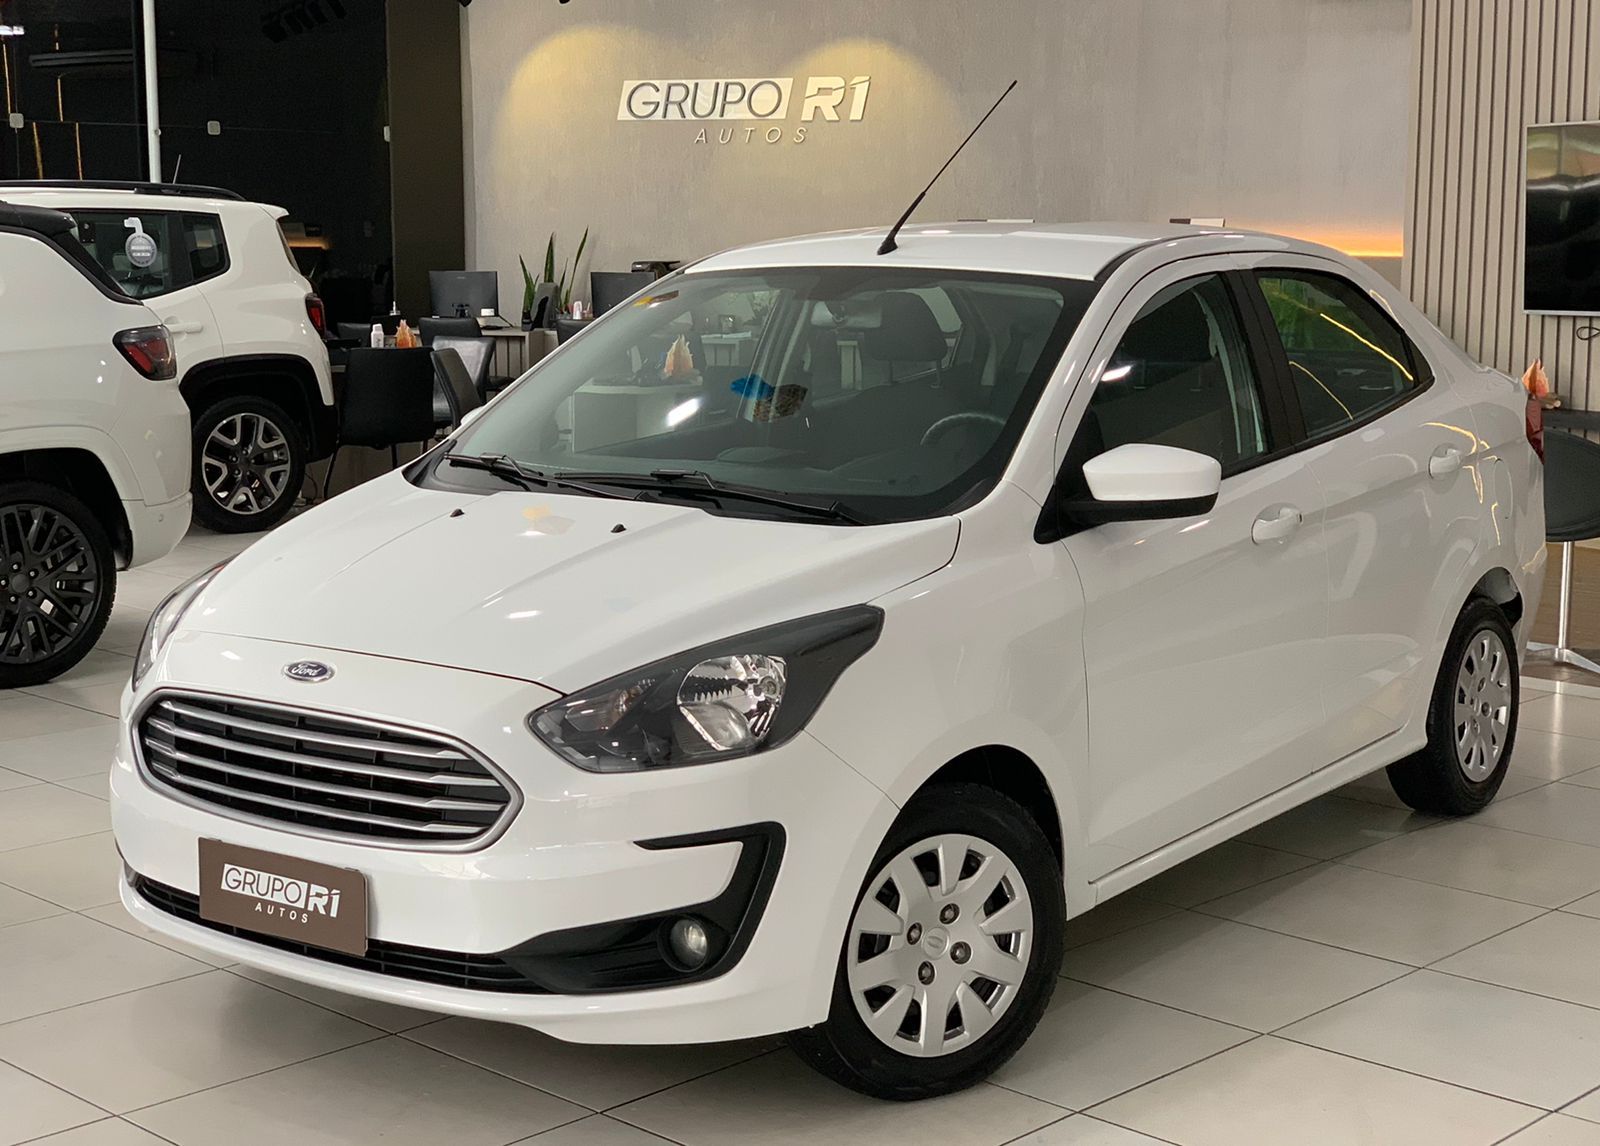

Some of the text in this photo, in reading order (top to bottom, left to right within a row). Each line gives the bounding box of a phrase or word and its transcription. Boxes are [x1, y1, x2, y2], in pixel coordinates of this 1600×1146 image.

[626, 76, 871, 121] GRUPO R1
[694, 127, 808, 144] AUTOS
[291, 663, 322, 676] Ford
[225, 867, 341, 918] GRUPO R1
[255, 902, 309, 923] AUTOS
